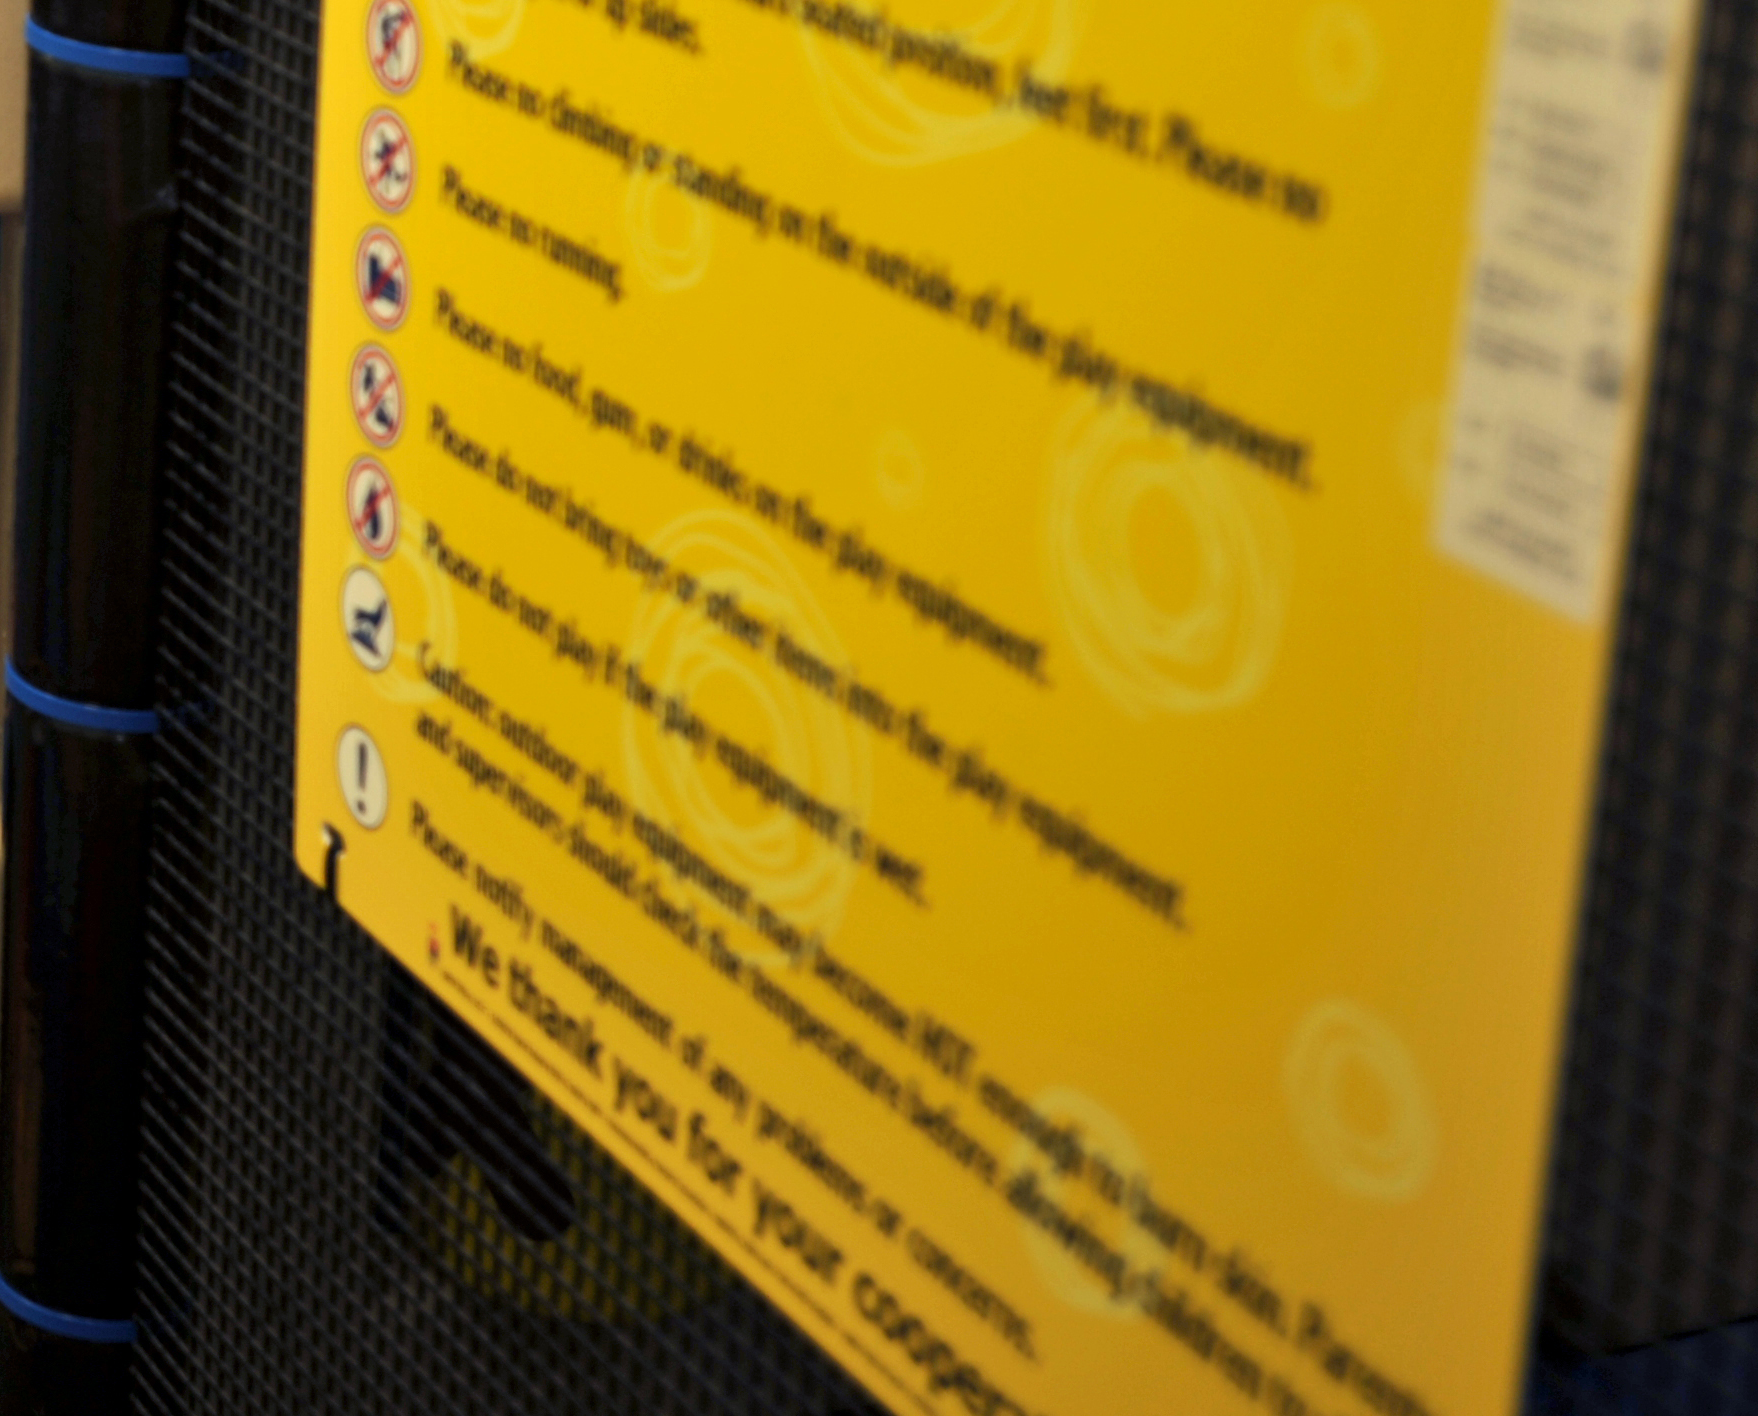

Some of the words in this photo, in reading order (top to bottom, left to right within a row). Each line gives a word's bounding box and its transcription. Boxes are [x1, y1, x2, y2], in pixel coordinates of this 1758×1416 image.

[450, 906, 500, 989] We
[508, 960, 602, 1077] thank
[612, 1058, 677, 1143] you
[687, 1110, 743, 1194] for
[751, 1180, 845, 1283] your
[852, 1272, 1030, 1416] coope
[1295, 1301, 1430, 1416] Paren
